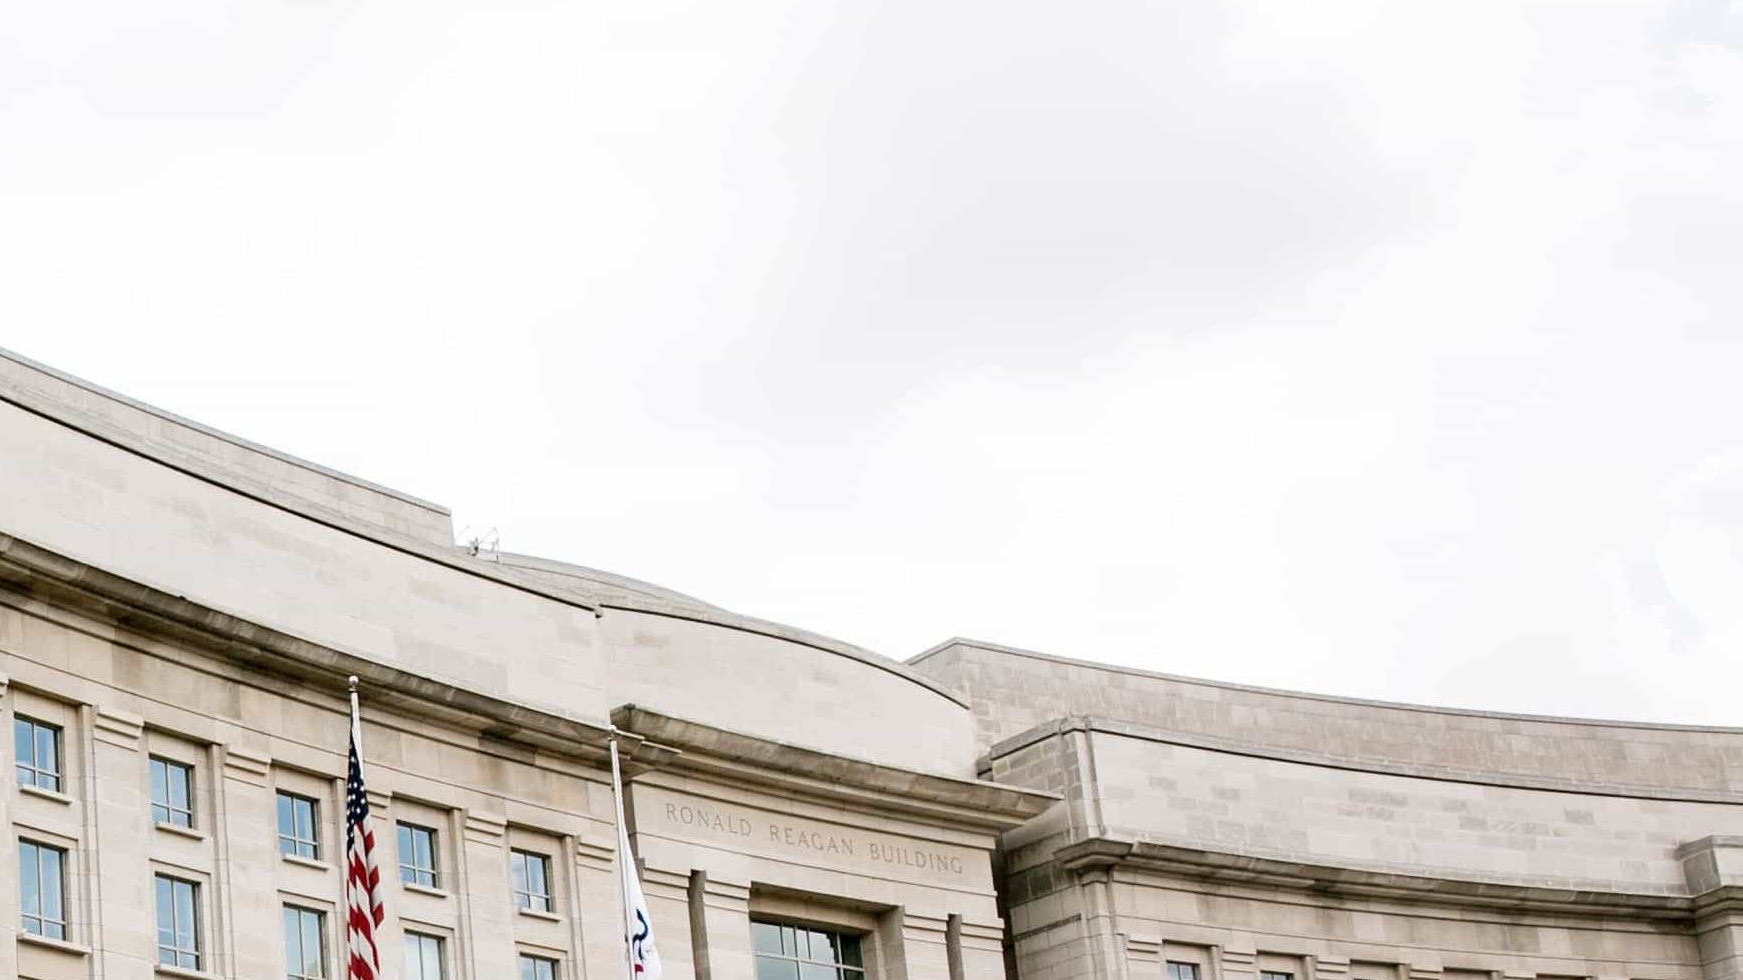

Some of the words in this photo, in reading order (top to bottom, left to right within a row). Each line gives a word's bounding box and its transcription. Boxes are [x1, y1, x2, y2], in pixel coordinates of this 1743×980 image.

[666, 803, 752, 836] RONALD
[769, 825, 854, 854] REAGAN
[869, 843, 963, 874] BUILDING
